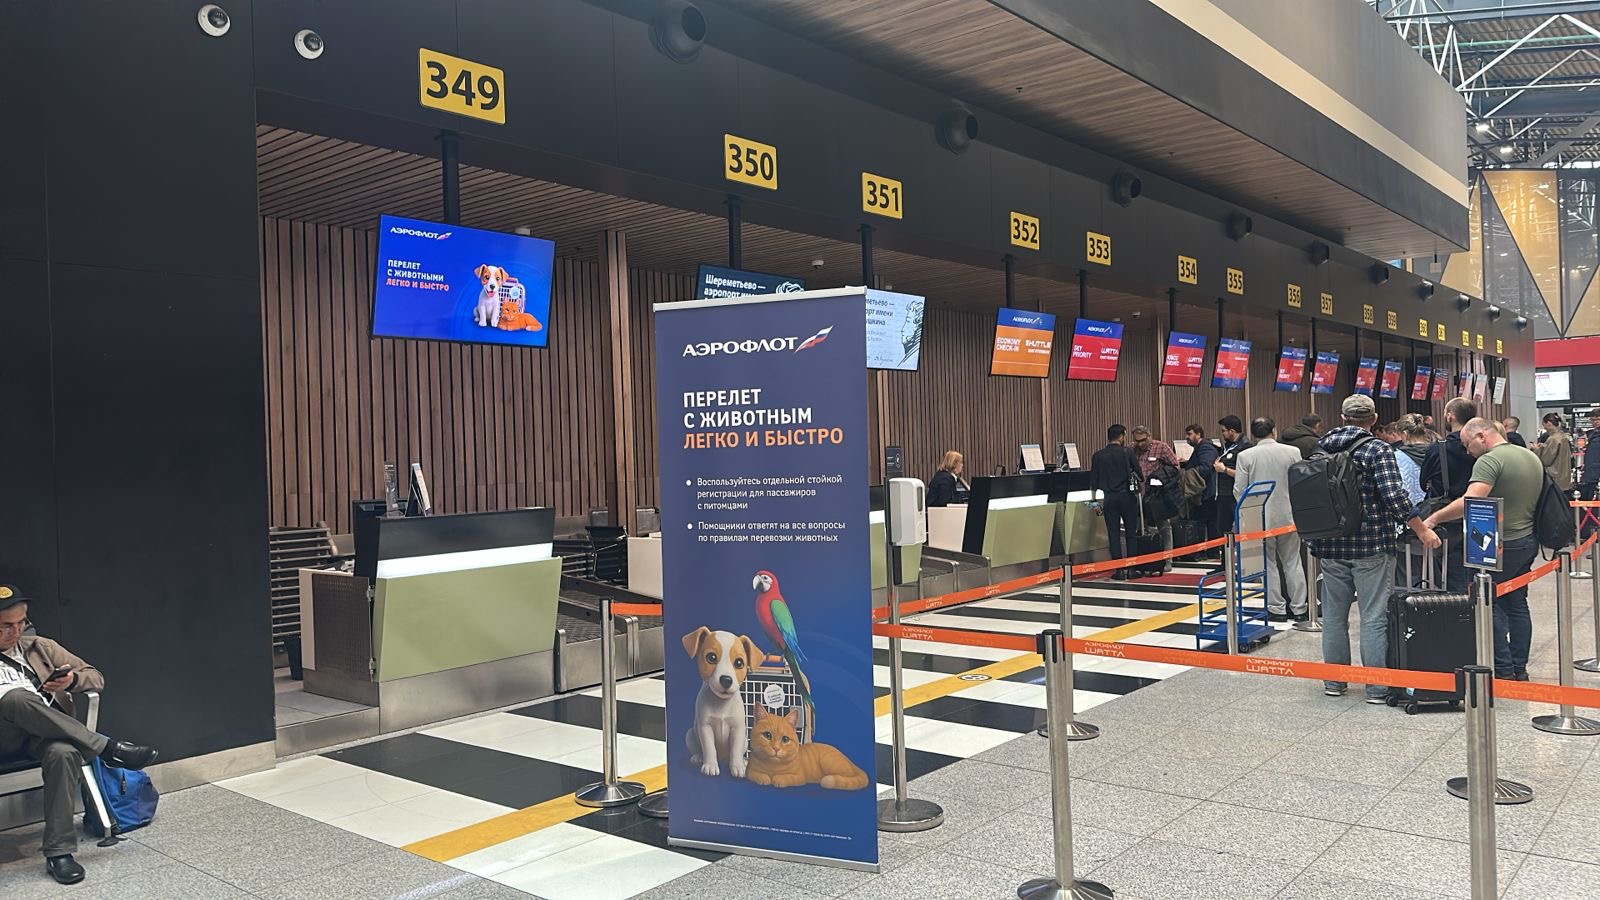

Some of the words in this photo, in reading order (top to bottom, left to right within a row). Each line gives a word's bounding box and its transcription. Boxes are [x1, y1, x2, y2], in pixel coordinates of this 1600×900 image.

[425, 60, 501, 111] 349
[728, 143, 773, 180] 350
[867, 180, 899, 212] 351
[390, 227, 438, 239] АЭРОФЛОТ
[1012, 218, 1038, 244] 352
[1088, 237, 1110, 260] 353
[388, 259, 421, 270] ПЕРЕЛЕТ
[1180, 260, 1196, 280] 354
[394, 269, 444, 282] ЖИВОТНЫМИ
[705, 273, 757, 291] Шереметьево
[1228, 272, 1242, 290] 355
[386, 278, 411, 287] ЛЕГКО
[419, 282, 449, 291] БЫСТРО
[1288, 287, 1300, 304] 356
[1322, 296, 1332, 312] 357
[682, 336, 798, 357] АЭРОФЛОТ
[996, 337, 1021, 346] ECONOMY
[996, 344, 1020, 352] CHECK-IN
[1025, 340, 1051, 349] SHUTTLE
[683, 388, 761, 408] ПЕРЕЛЕТ
[683, 412, 695, 428] С
[700, 407, 812, 428] ЖИВОТНЫМ
[683, 431, 739, 449] ЛЕГКО
[745, 430, 759, 447] И
[765, 427, 843, 447] БЫСТРО
[697, 477, 761, 488] Воспользуйтесь
[762, 475, 805, 485] отдельной
[807, 474, 843, 484] стойкой
[697, 489, 747, 500] регистрации
[749, 489, 764, 497] для
[766, 488, 816, 498] пассажиров
[703, 502, 748, 511] питомцами
[698, 521, 746, 531] Помощники
[748, 522, 778, 530] ответят
[780, 522, 790, 530] на
[792, 522, 806, 530] все
[808, 521, 845, 531] вопросы
[698, 534, 708, 542] по
[709, 533, 748, 543] правилам
[750, 533, 793, 543] перевозки
[794, 533, 838, 542] животных
[1084, 641, 1125, 650] АЭРОФЛОТ
[1084, 647, 1126, 657] ШАТТЛ
[1246, 658, 1294, 667] АЭРОФЛОТ
[1246, 664, 1295, 675] ШАТТЛ
